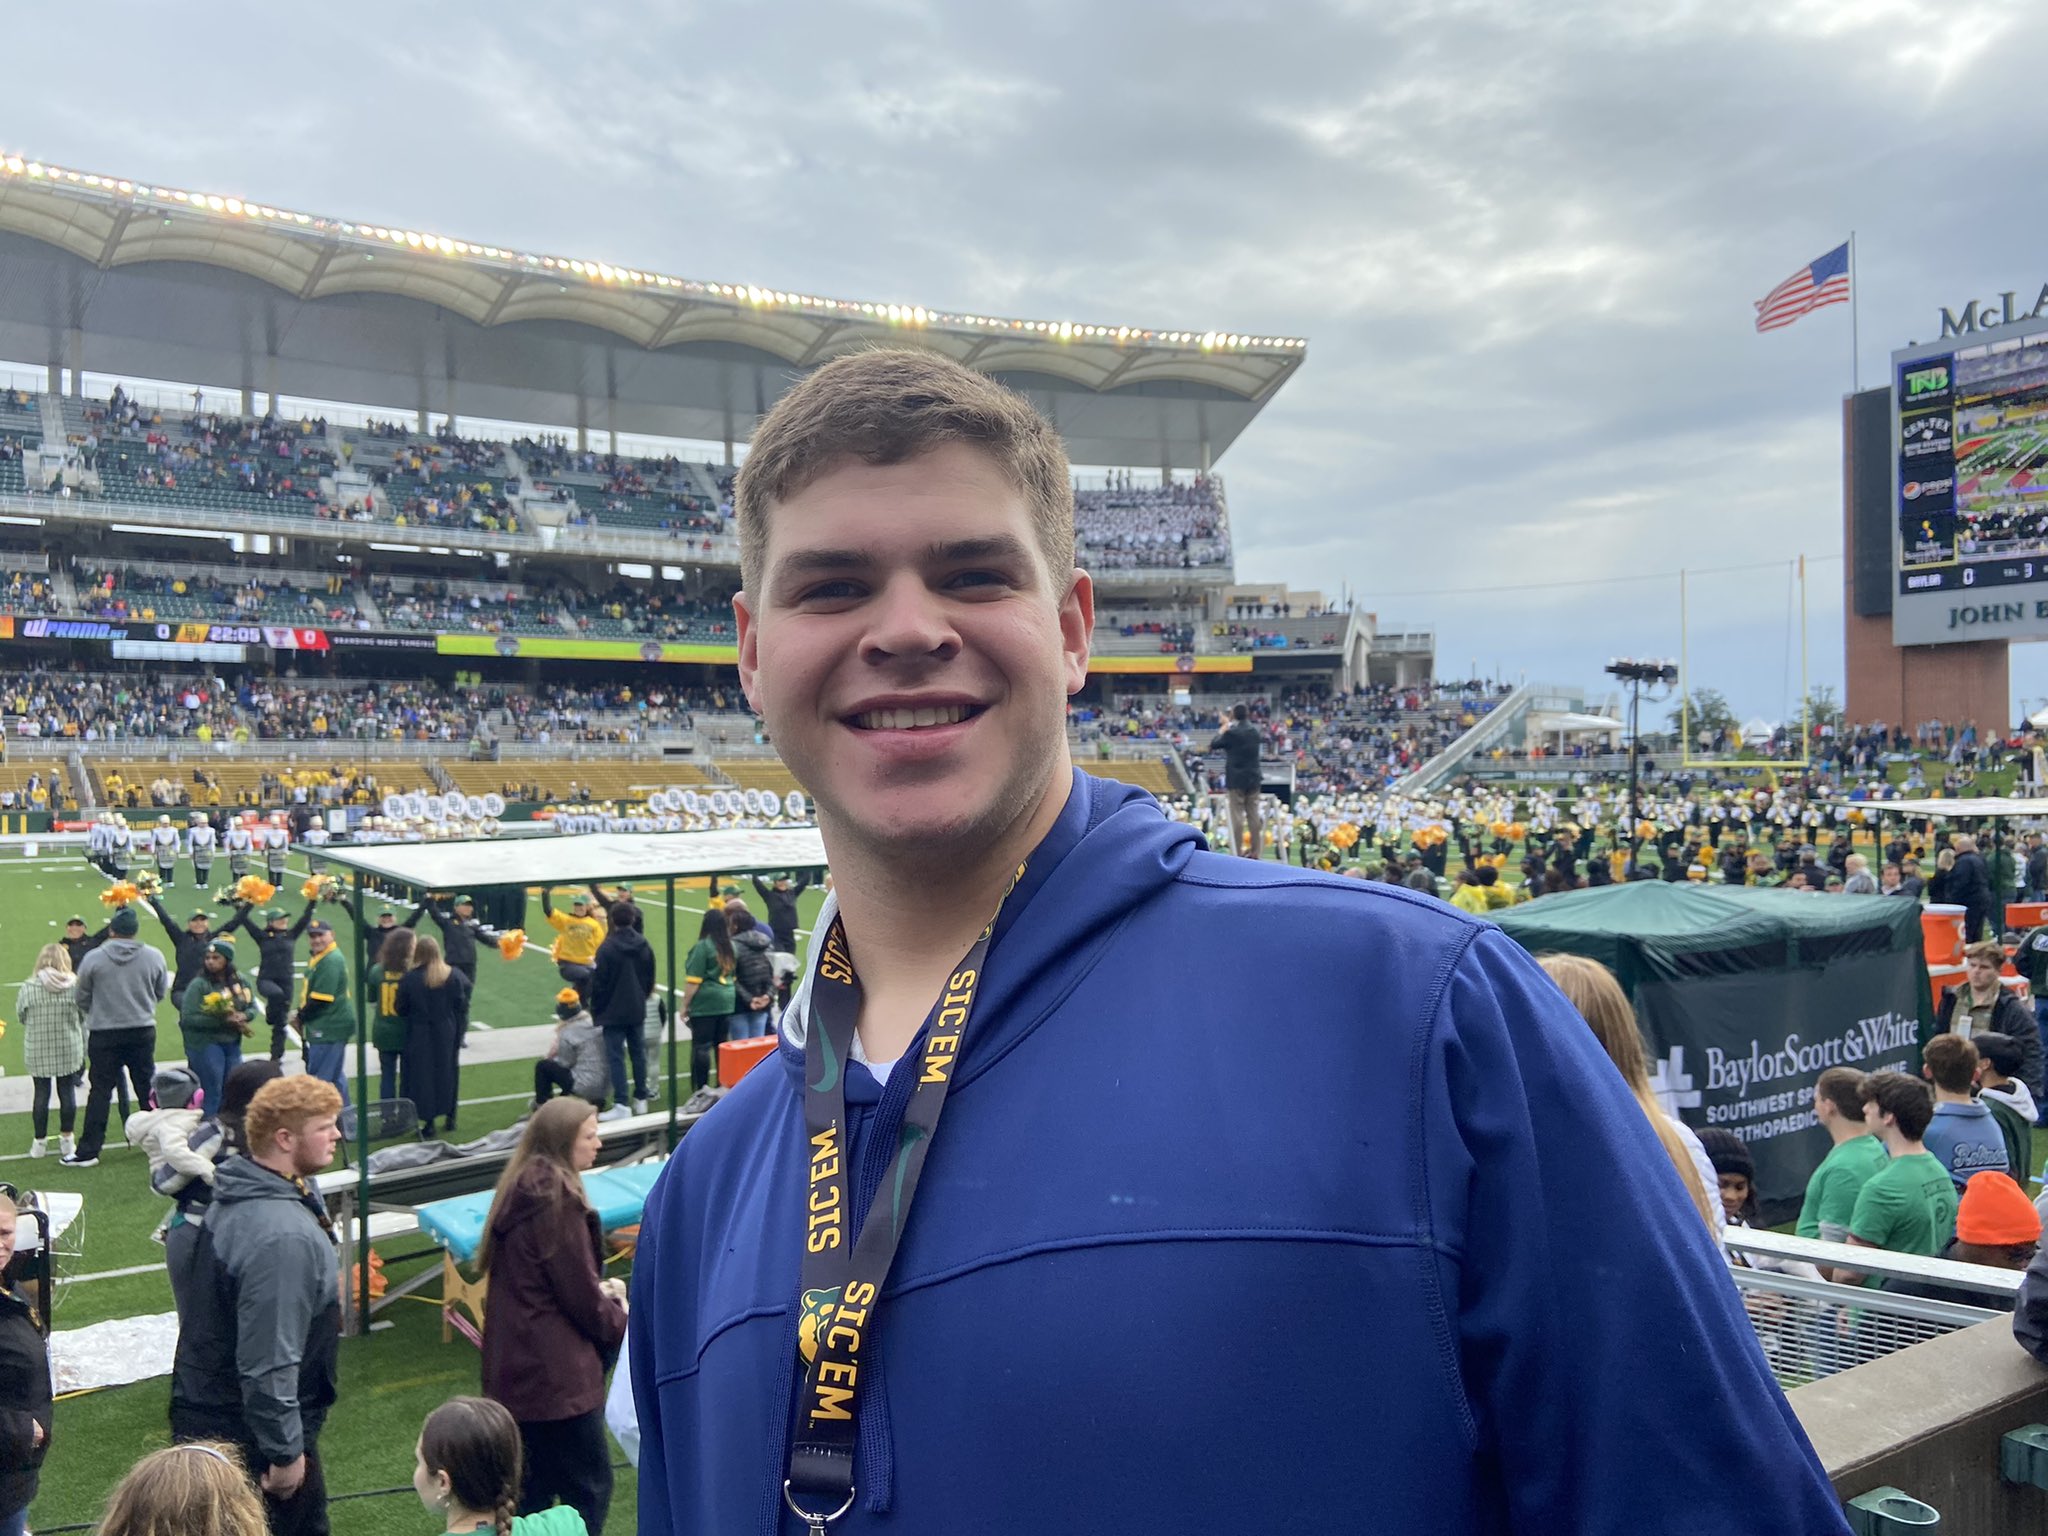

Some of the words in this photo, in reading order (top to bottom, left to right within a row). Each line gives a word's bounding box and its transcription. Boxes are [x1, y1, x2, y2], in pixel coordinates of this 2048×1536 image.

[1963, 568, 1974, 585] 0
[2024, 563, 2033, 578] 3
[1948, 602, 2023, 630] JOHN
[1706, 1090, 1795, 1123] SOUTHWEST
[1727, 1109, 1818, 1142] RTHOPAEDIC
